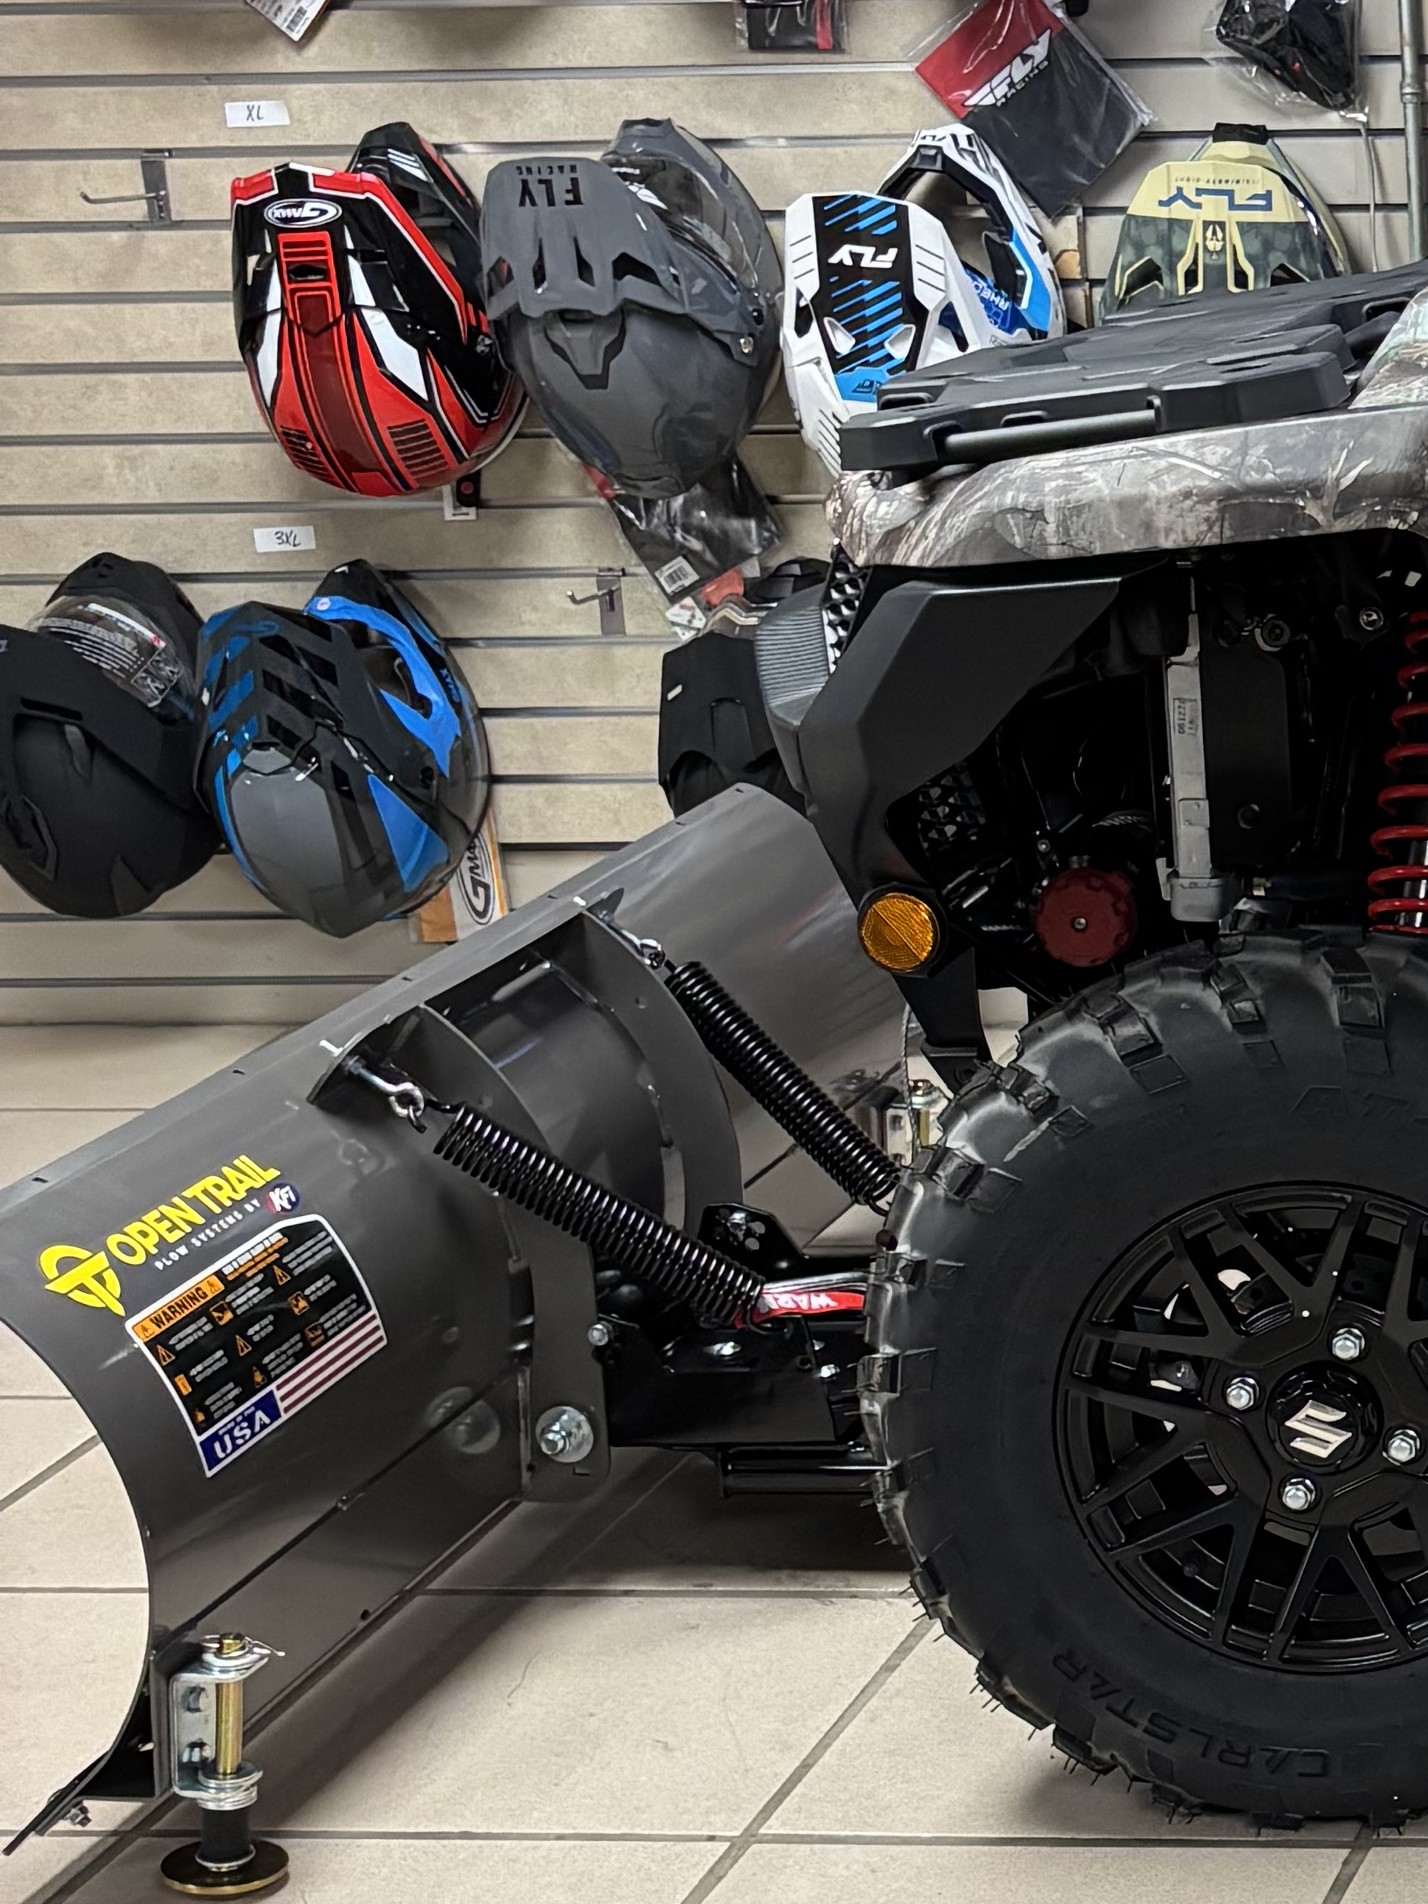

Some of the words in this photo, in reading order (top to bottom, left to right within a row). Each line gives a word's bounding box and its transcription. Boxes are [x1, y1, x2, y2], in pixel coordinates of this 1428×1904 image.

[245, 104, 265, 122] XL
[519, 177, 584, 207] FLY
[1157, 186, 1273, 212] FLY
[272, 203, 341, 228] GMAX
[827, 243, 898, 269] FLY
[274, 530, 302, 548] 3XL
[460, 837, 492, 920] GMA
[105, 1196, 206, 1265] OPEN
[182, 1154, 281, 1214] TRAIL
[150, 1287, 207, 1330] WARNING
[213, 1409, 272, 1460] USA
[1051, 1644, 1331, 1778] CARLSTAR
